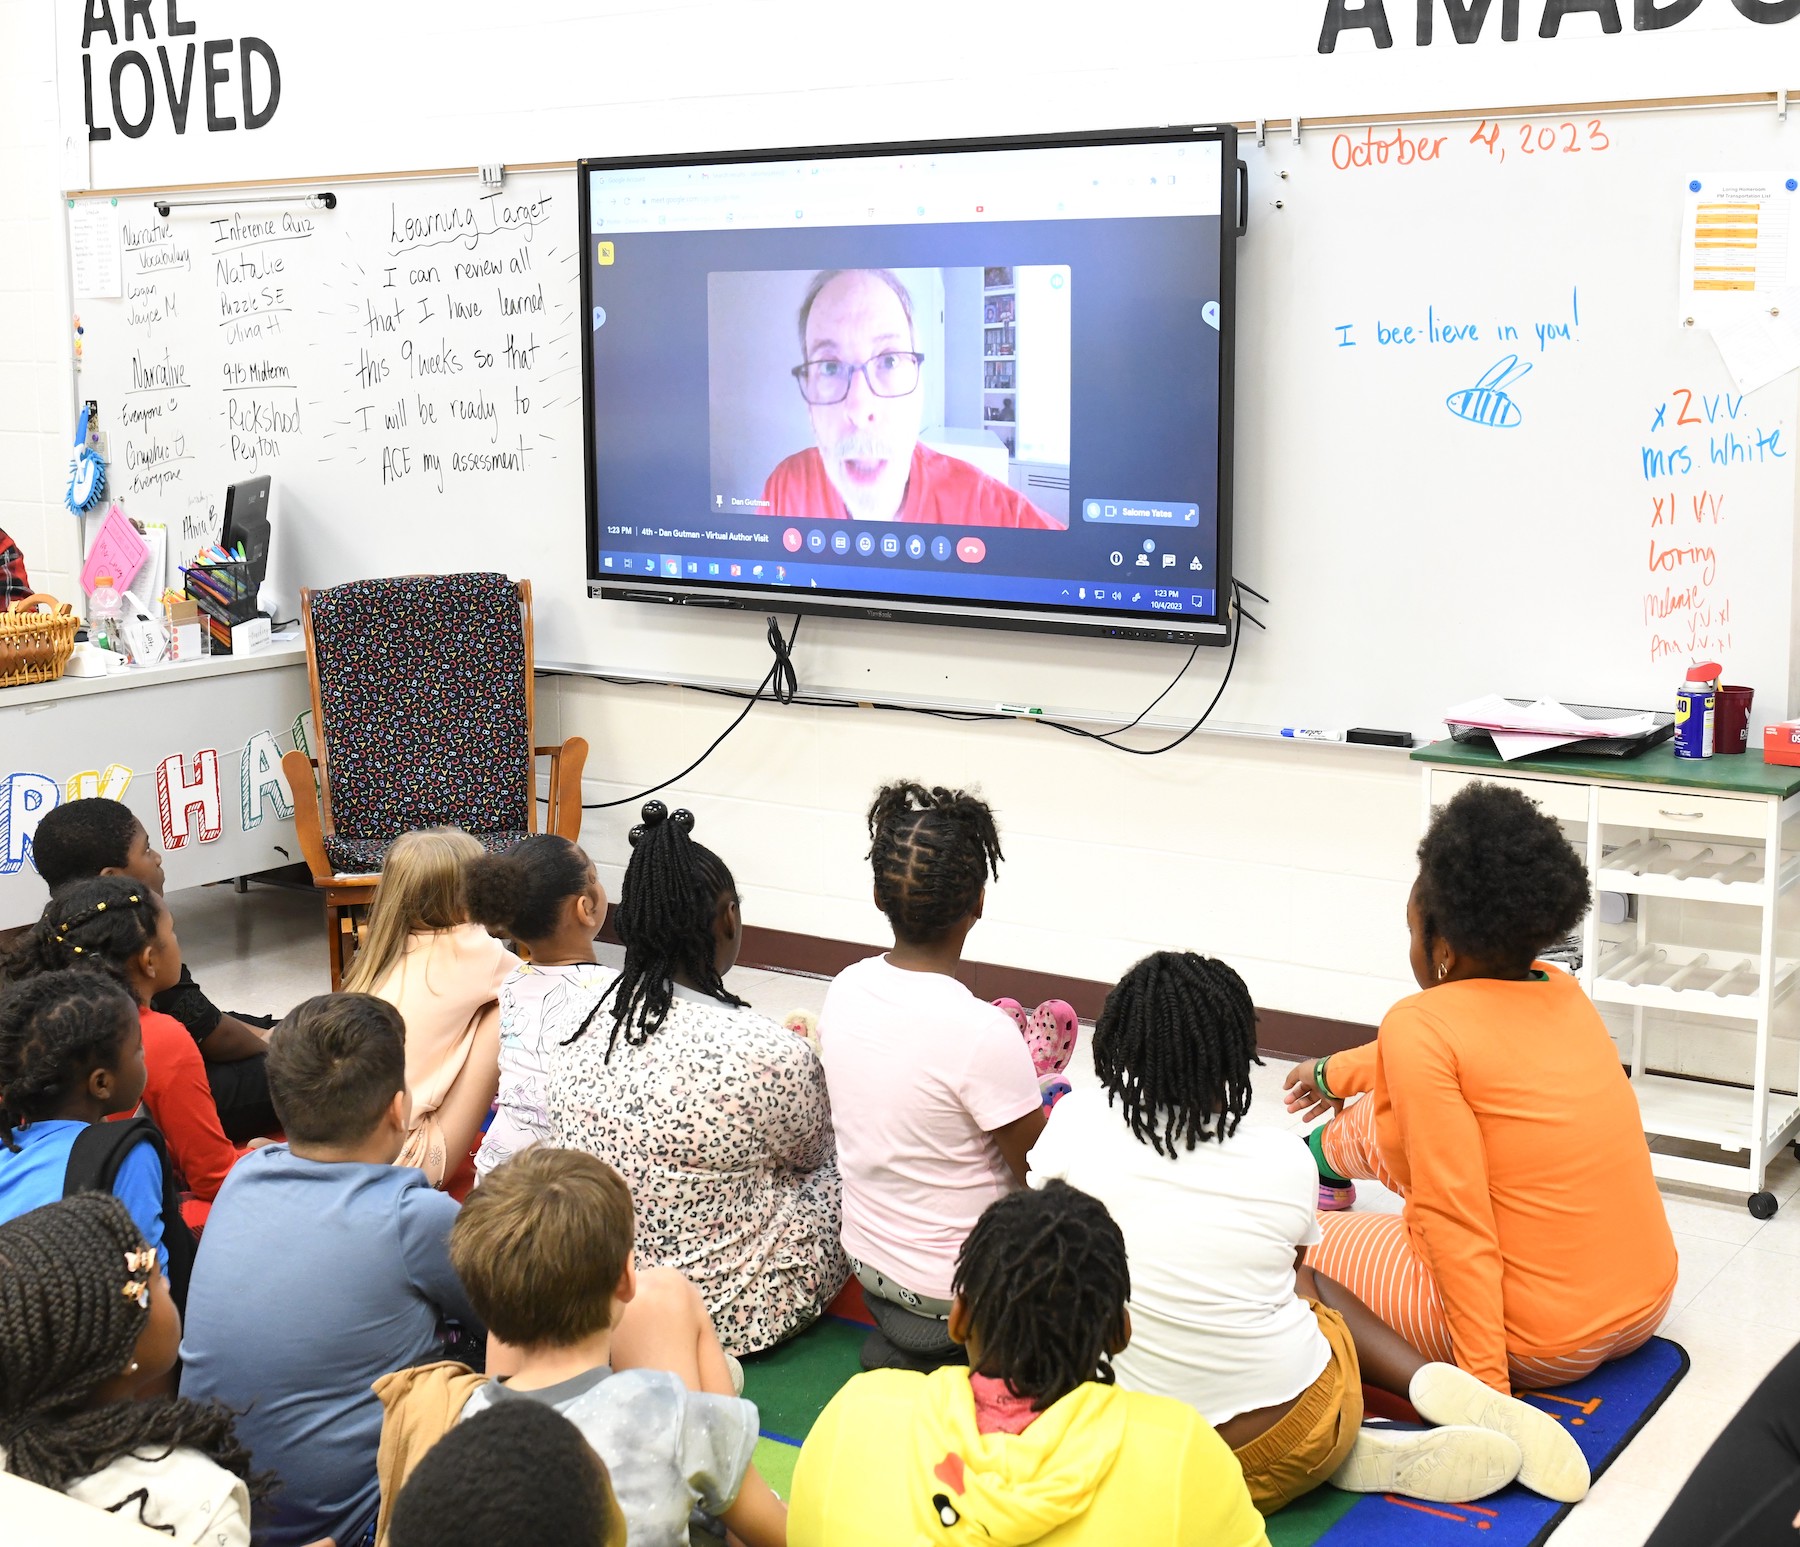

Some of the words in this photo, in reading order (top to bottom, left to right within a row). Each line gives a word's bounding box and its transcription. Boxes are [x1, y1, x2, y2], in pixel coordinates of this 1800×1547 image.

[82, 36, 282, 141] LOVED
[1331, 127, 1448, 170] October
[1519, 119, 1610, 155] 2023
[122, 217, 173, 246] Narrative
[210, 211, 276, 243] Inference
[282, 212, 315, 236] Quiz
[391, 202, 479, 250] Learning
[480, 190, 552, 243] Target
[139, 244, 191, 271] Vocabulary
[215, 252, 285, 288] Natalie
[383, 267, 397, 288] I
[409, 266, 440, 285] can
[454, 257, 503, 281] review
[509, 246, 531, 275] all
[363, 298, 405, 338] that
[418, 297, 435, 324] I
[447, 293, 482, 319] have
[497, 283, 546, 316] learned
[1335, 324, 1356, 347] I
[1377, 305, 1479, 345] bee-lieve
[1497, 324, 1519, 341] in
[1535, 285, 1580, 352] you!
[132, 347, 187, 389] Narrative
[249, 360, 290, 383] Midterm
[355, 347, 390, 389] this
[401, 339, 413, 379] 9
[418, 337, 464, 377] weeks
[474, 349, 494, 369] so
[502, 332, 540, 370] that
[355, 405, 375, 433] I
[385, 398, 407, 430] will
[417, 393, 438, 425] be
[450, 388, 498, 444] ready
[514, 385, 531, 415] to
[1711, 427, 1787, 466] White
[382, 446, 411, 485] ACE
[423, 452, 444, 494] my
[731, 497, 743, 506] Dan
[744, 499, 770, 507] Gutman
[607, 526, 620, 535] 1:23
[621, 527, 632, 535] PM
[641, 528, 653, 536] 4th
[659, 529, 672, 538] Dan
[673, 530, 700, 539] Gutman
[706, 531, 727, 541] Virtual
[729, 533, 752, 542] Author
[753, 534, 769, 543] Visit
[1649, 539, 1716, 586] Loring
[1151, 601, 1182, 611] 10/4/2023
[1154, 589, 1167, 598] 1:23
[1168, 590, 1179, 599] PM
[1643, 585, 1705, 627] Melanie
